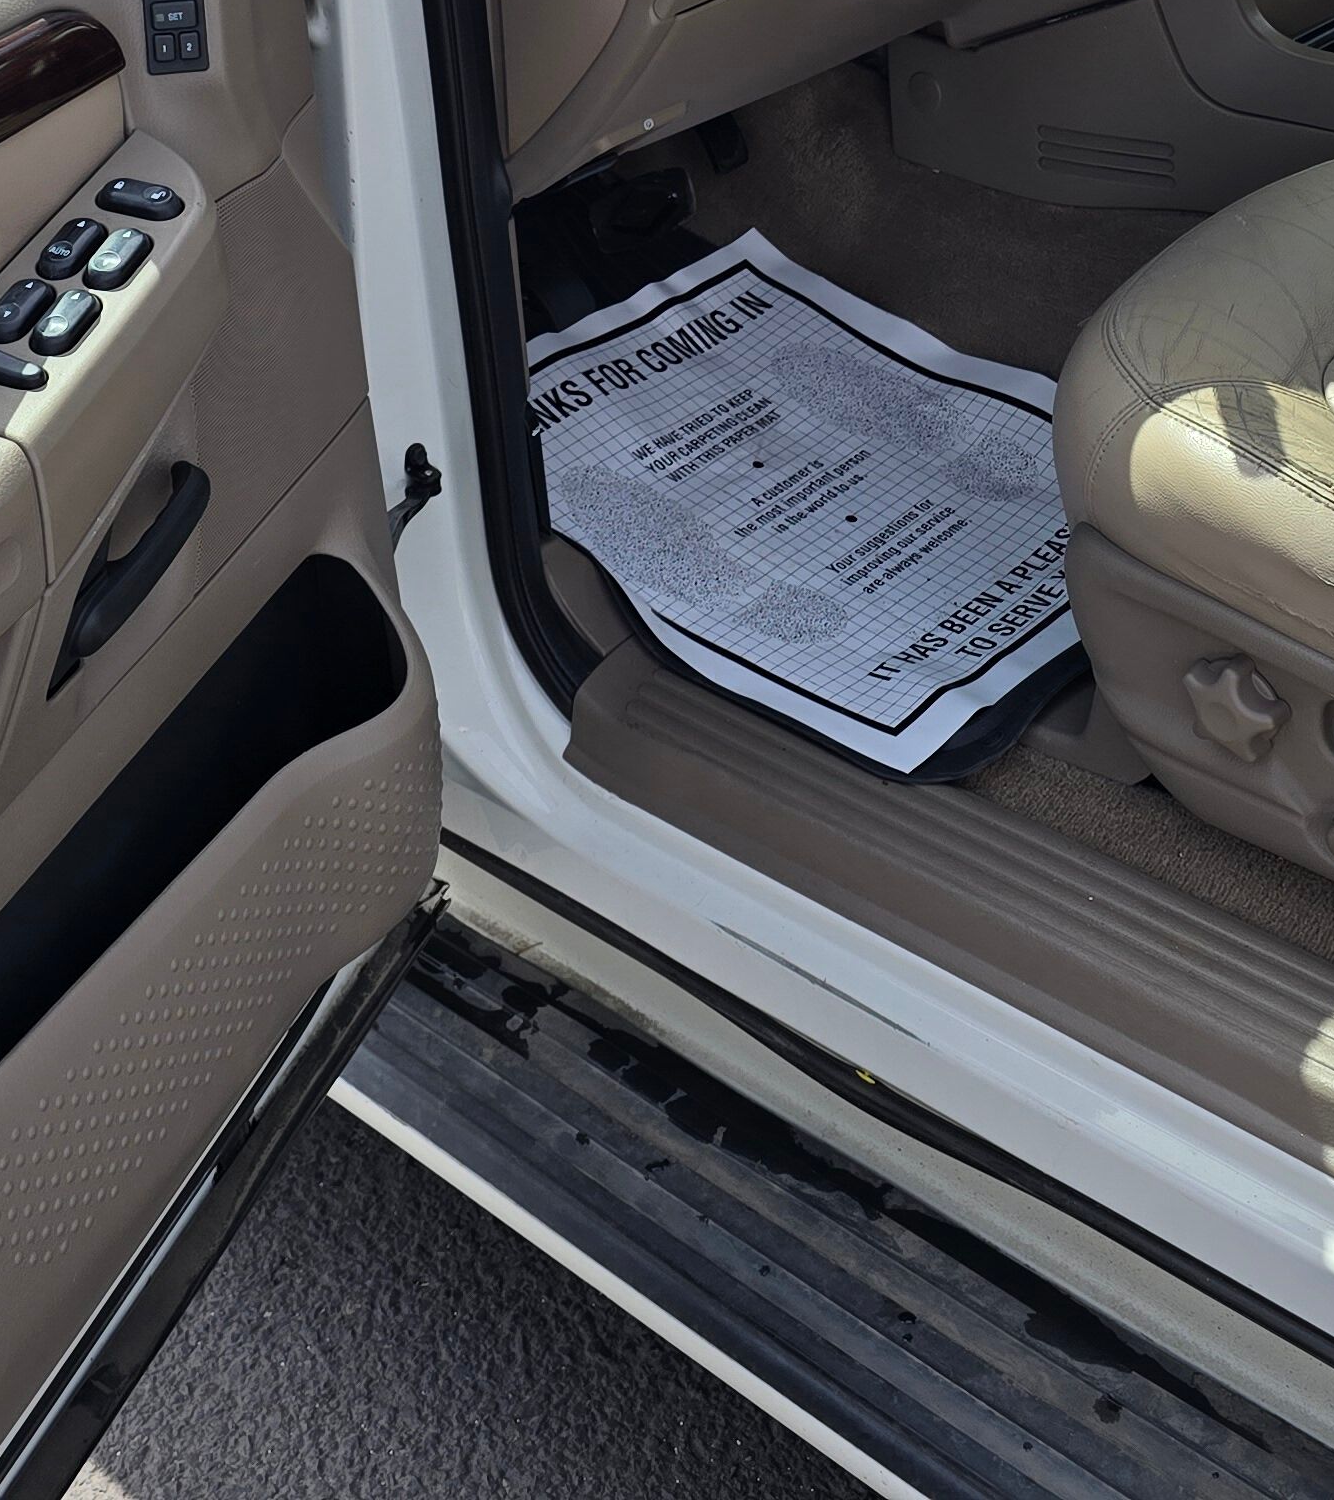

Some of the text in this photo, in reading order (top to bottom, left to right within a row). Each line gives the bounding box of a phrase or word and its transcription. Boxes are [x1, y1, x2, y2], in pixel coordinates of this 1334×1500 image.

[162, 42, 193, 53] 1 2
[167, 12, 184, 21] SET
[48, 245, 71, 257] AUTO
[528, 290, 774, 433] NKS FOR COMING IN
[632, 388, 755, 461] WE HAVE TRIED TO KEEP
[644, 397, 773, 475] YOUR CARPETING CLEAN
[667, 409, 782, 483] WITH THIS PAPER MAT
[734, 449, 872, 538] the most important person
[751, 459, 825, 507] A customer is
[772, 522, 789, 534] in
[784, 510, 808, 526] the
[806, 489, 838, 514] world
[834, 483, 850, 494] to
[826, 499, 936, 574] Your suggestions for
[840, 506, 956, 587] improving our service
[862, 517, 973, 595] are always welcome.
[868, 523, 1071, 682] IT HAS BEEN A PLEAS
[954, 583, 1066, 658] TO SERVE
